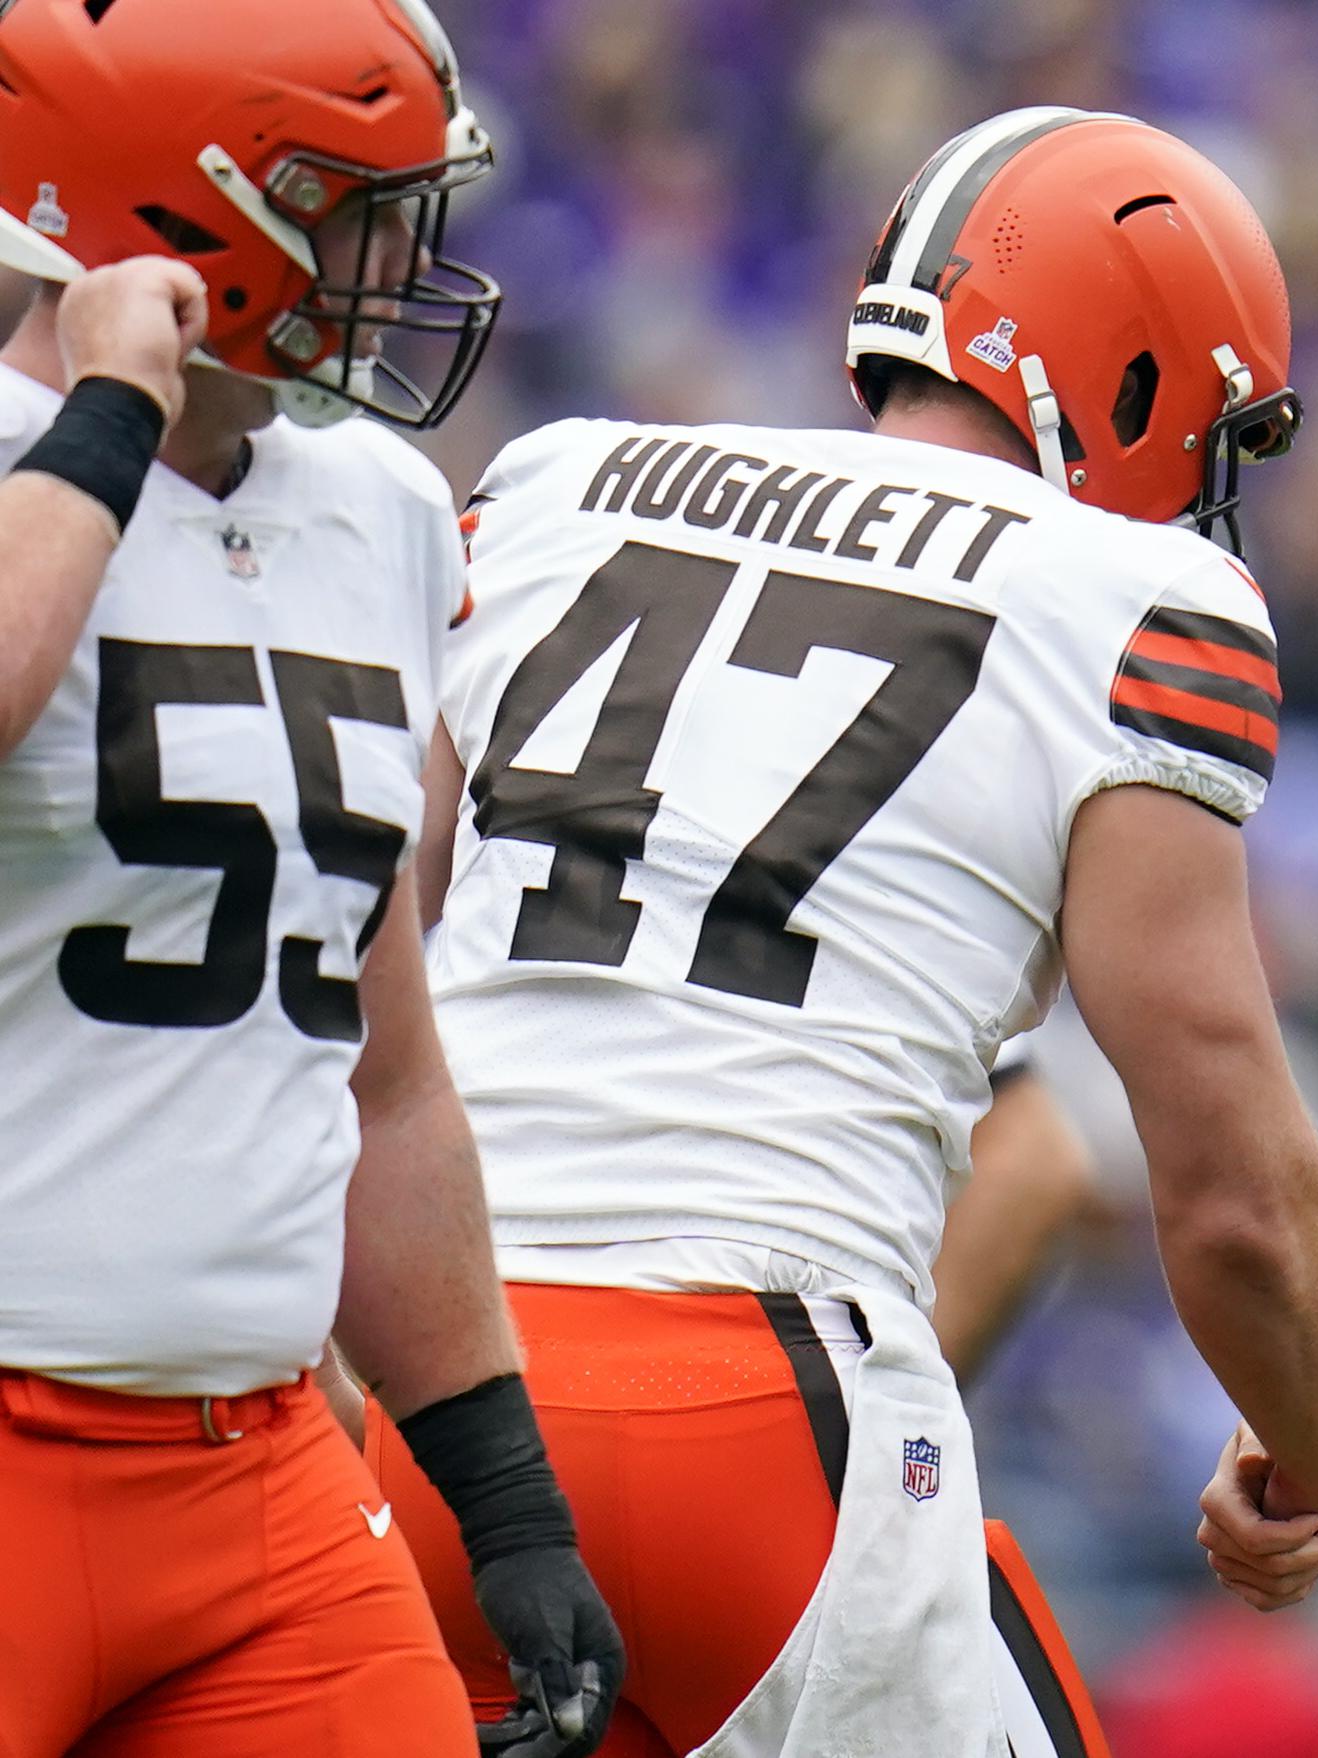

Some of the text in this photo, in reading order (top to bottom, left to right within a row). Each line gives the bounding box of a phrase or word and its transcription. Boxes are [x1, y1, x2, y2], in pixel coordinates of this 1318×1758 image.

[973, 338, 1014, 366] CATCH
[579, 437, 1032, 582] HUGHLETT
[57, 636, 411, 1043] 55
[467, 540, 997, 1009] 47
[906, 1462, 936, 1495] NFL
